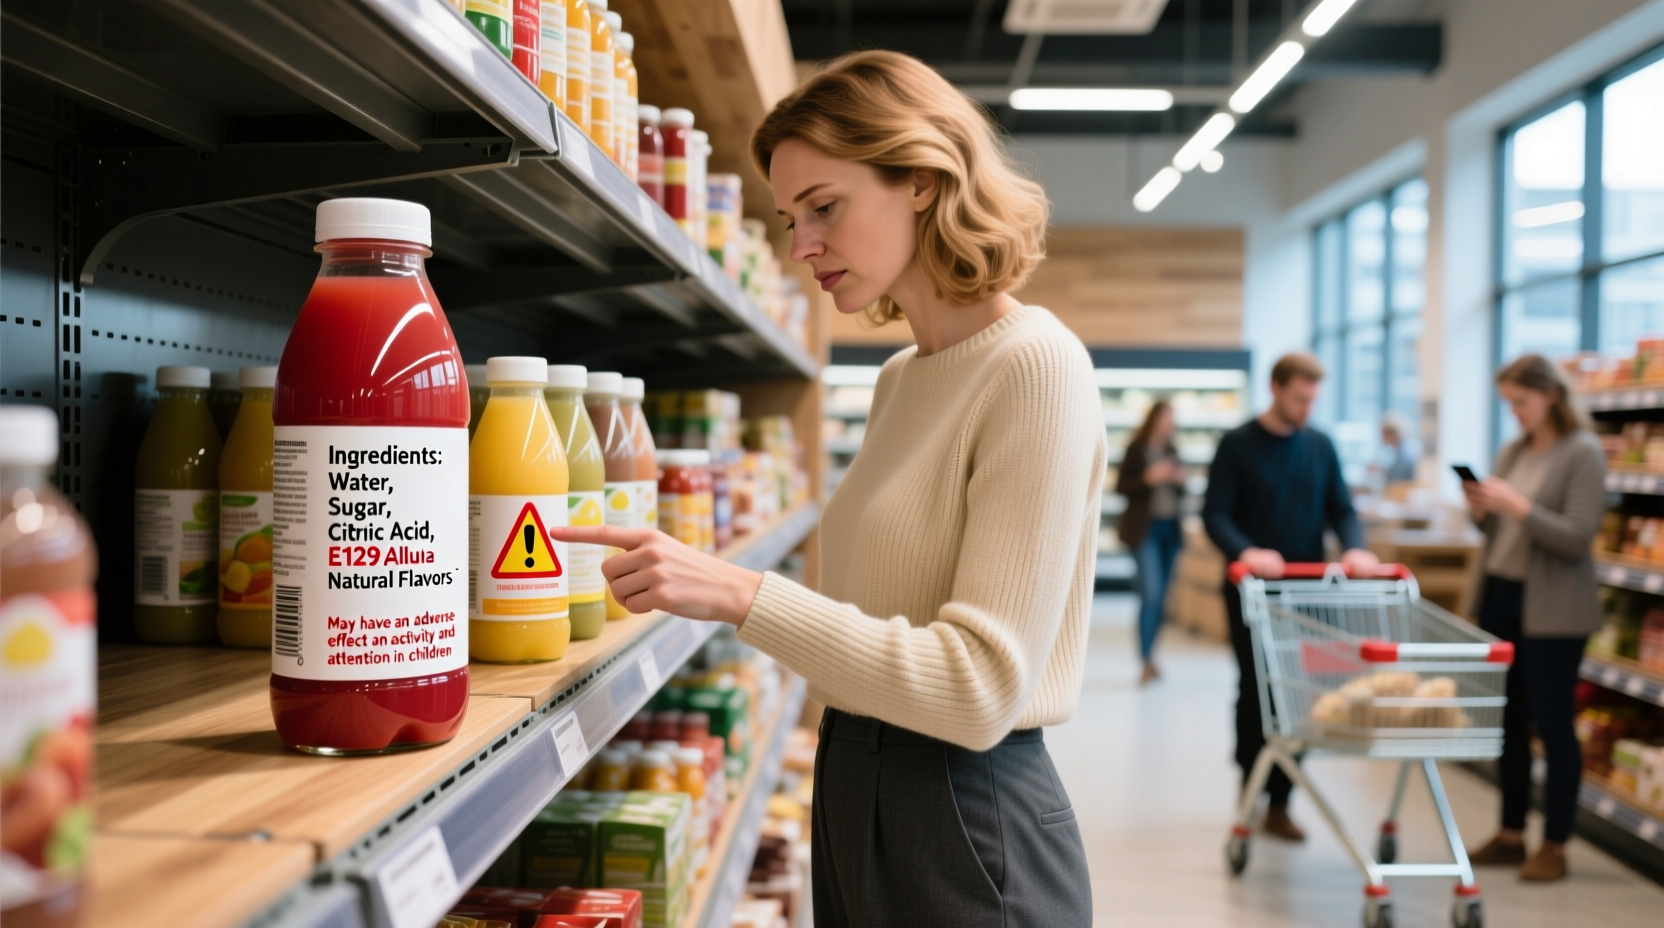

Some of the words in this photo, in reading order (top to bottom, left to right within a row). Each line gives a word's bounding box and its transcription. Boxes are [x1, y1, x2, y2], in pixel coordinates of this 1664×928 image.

[329, 445, 441, 469] Ingredients:
[328, 472, 393, 494] Water,
[328, 497, 391, 521] Sugar,
[390, 521, 434, 543] Acid,
[329, 546, 380, 566] E129
[328, 571, 393, 589] Natural
[399, 570, 452, 587] Flavors
[328, 616, 355, 634] May
[361, 616, 391, 630] have
[328, 633, 367, 647] effect
[328, 651, 390, 665] attention
[394, 650, 404, 662] in
[408, 645, 452, 661] children
